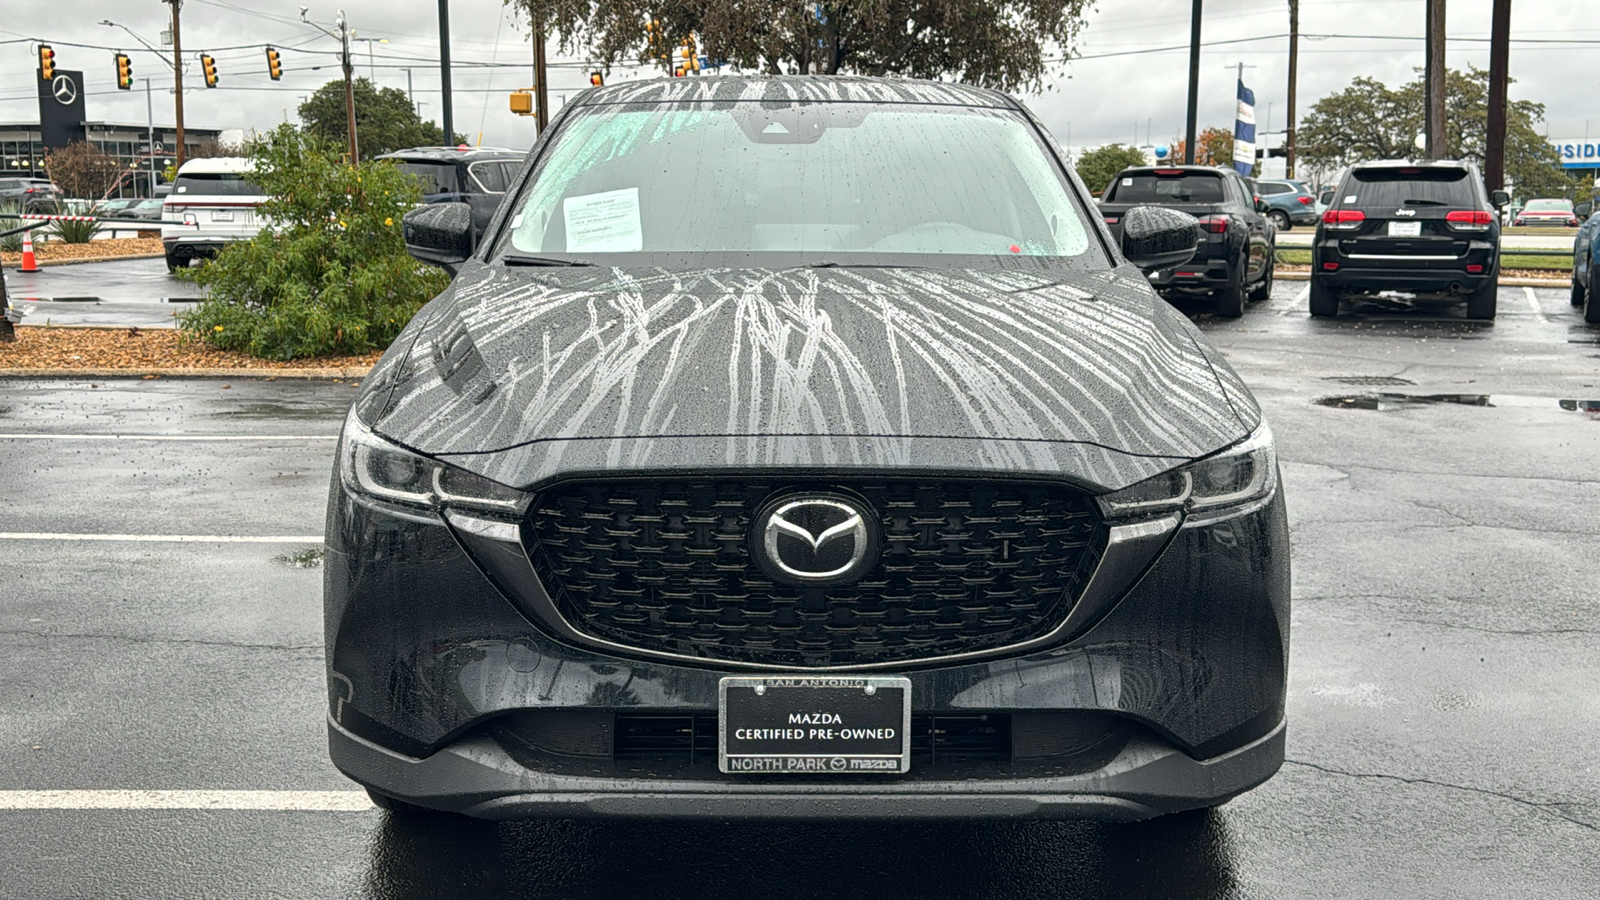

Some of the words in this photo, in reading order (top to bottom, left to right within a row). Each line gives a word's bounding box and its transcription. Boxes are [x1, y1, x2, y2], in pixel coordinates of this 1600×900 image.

[1395, 208, 1416, 217] Jeep
[788, 713, 842, 724] MAZDA
[735, 728, 804, 740] CERTIFIED
[809, 728, 895, 740] PRE-OWNED
[731, 759, 782, 770] NORTH
[787, 758, 827, 770] PARK
[849, 758, 898, 769] mazda
